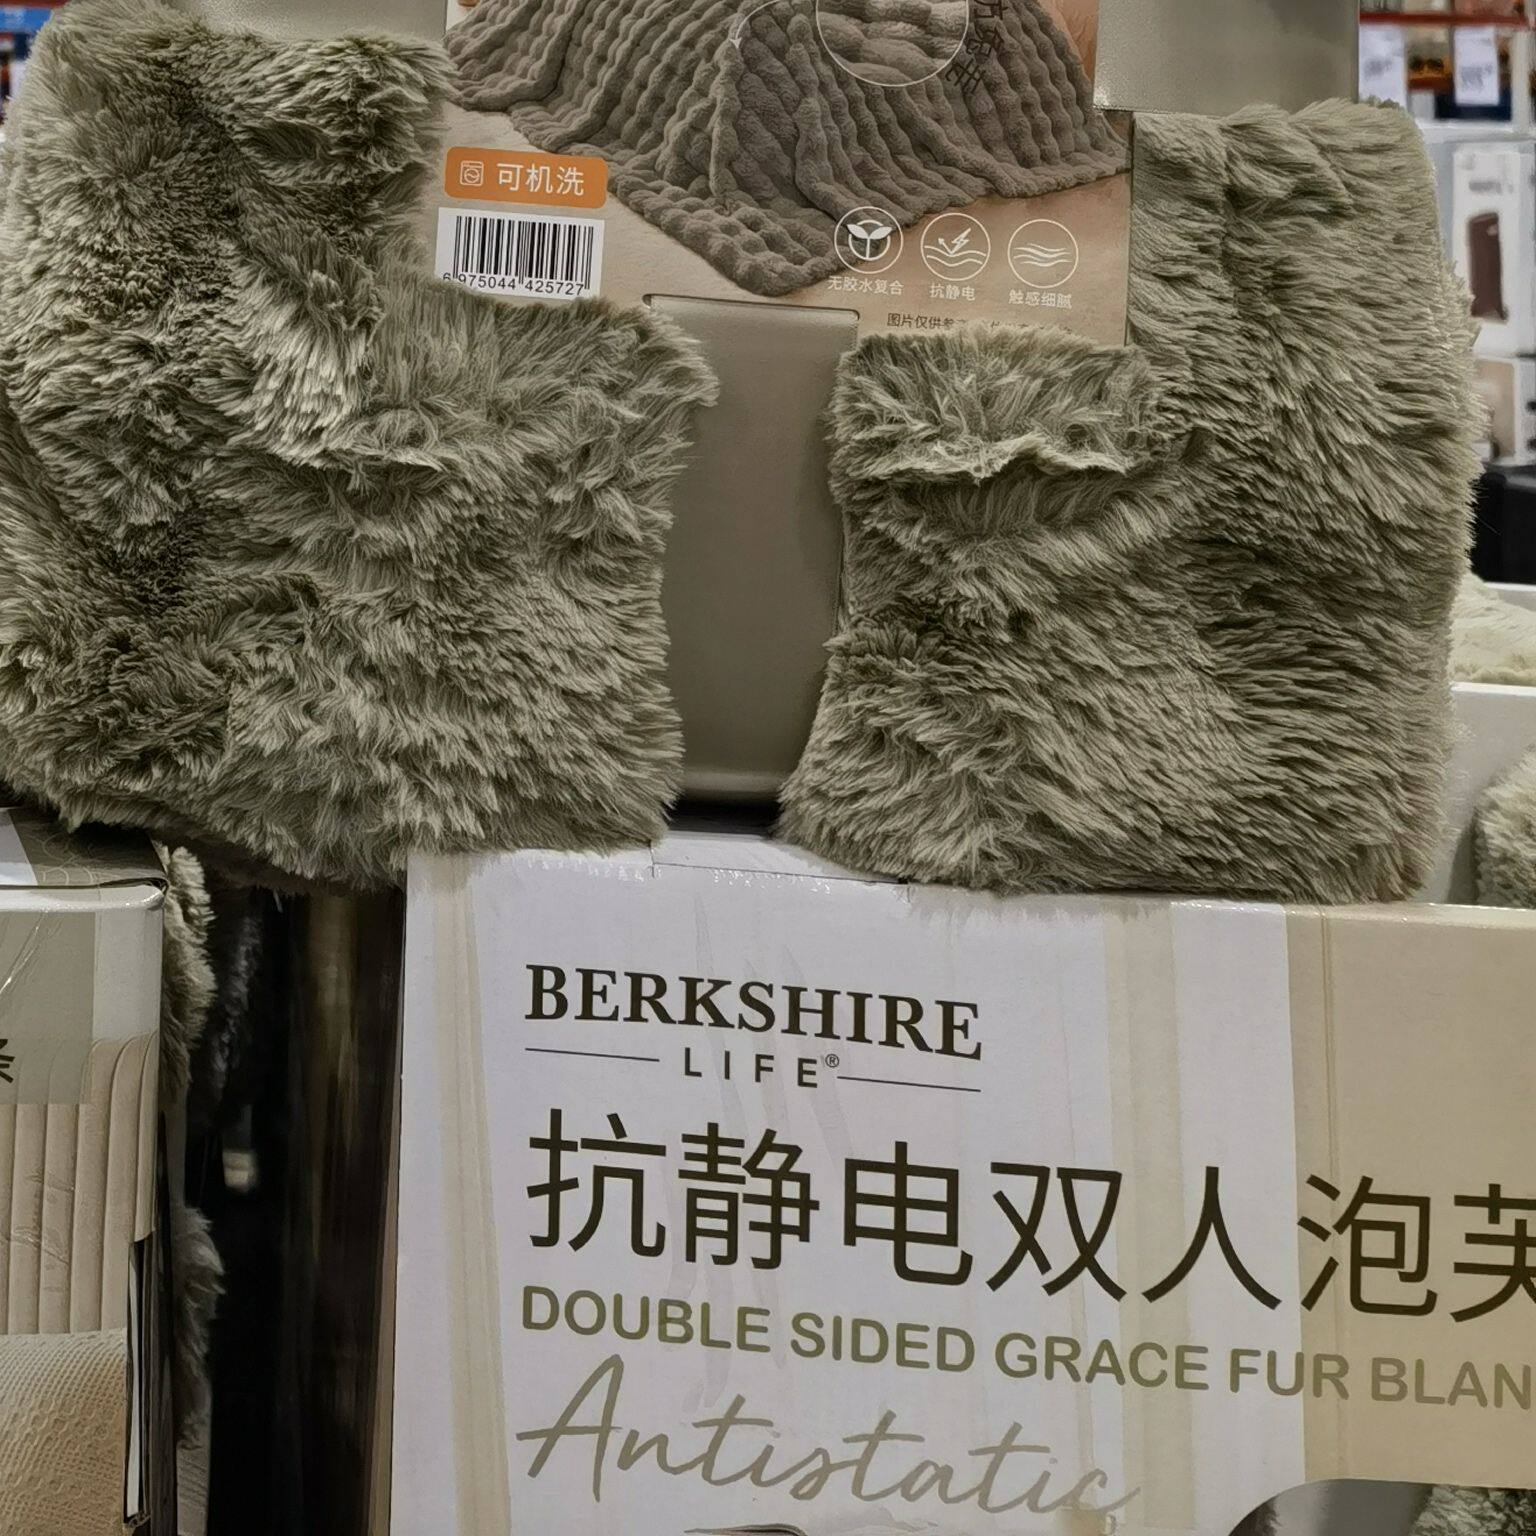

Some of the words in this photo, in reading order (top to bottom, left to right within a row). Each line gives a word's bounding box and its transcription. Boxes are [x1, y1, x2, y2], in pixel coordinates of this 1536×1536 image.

[496, 164, 585, 195] 可机洗
[828, 276, 904, 295] 无胶水复合
[929, 283, 976, 301] 抗静电
[1008, 289, 1072, 309] 触感细腻
[525, 963, 983, 1061] BERKSHIRE
[526, 1108, 1536, 1325] 抗静电双人泡芙
[522, 1286, 770, 1353] DOUBLE
[790, 1312, 975, 1372] SIDED
[996, 1331, 1209, 1391] GRACE
[1229, 1348, 1349, 1400] FUR
[1371, 1357, 1532, 1409] BLAN
[517, 1354, 1139, 1516] Antistatic
